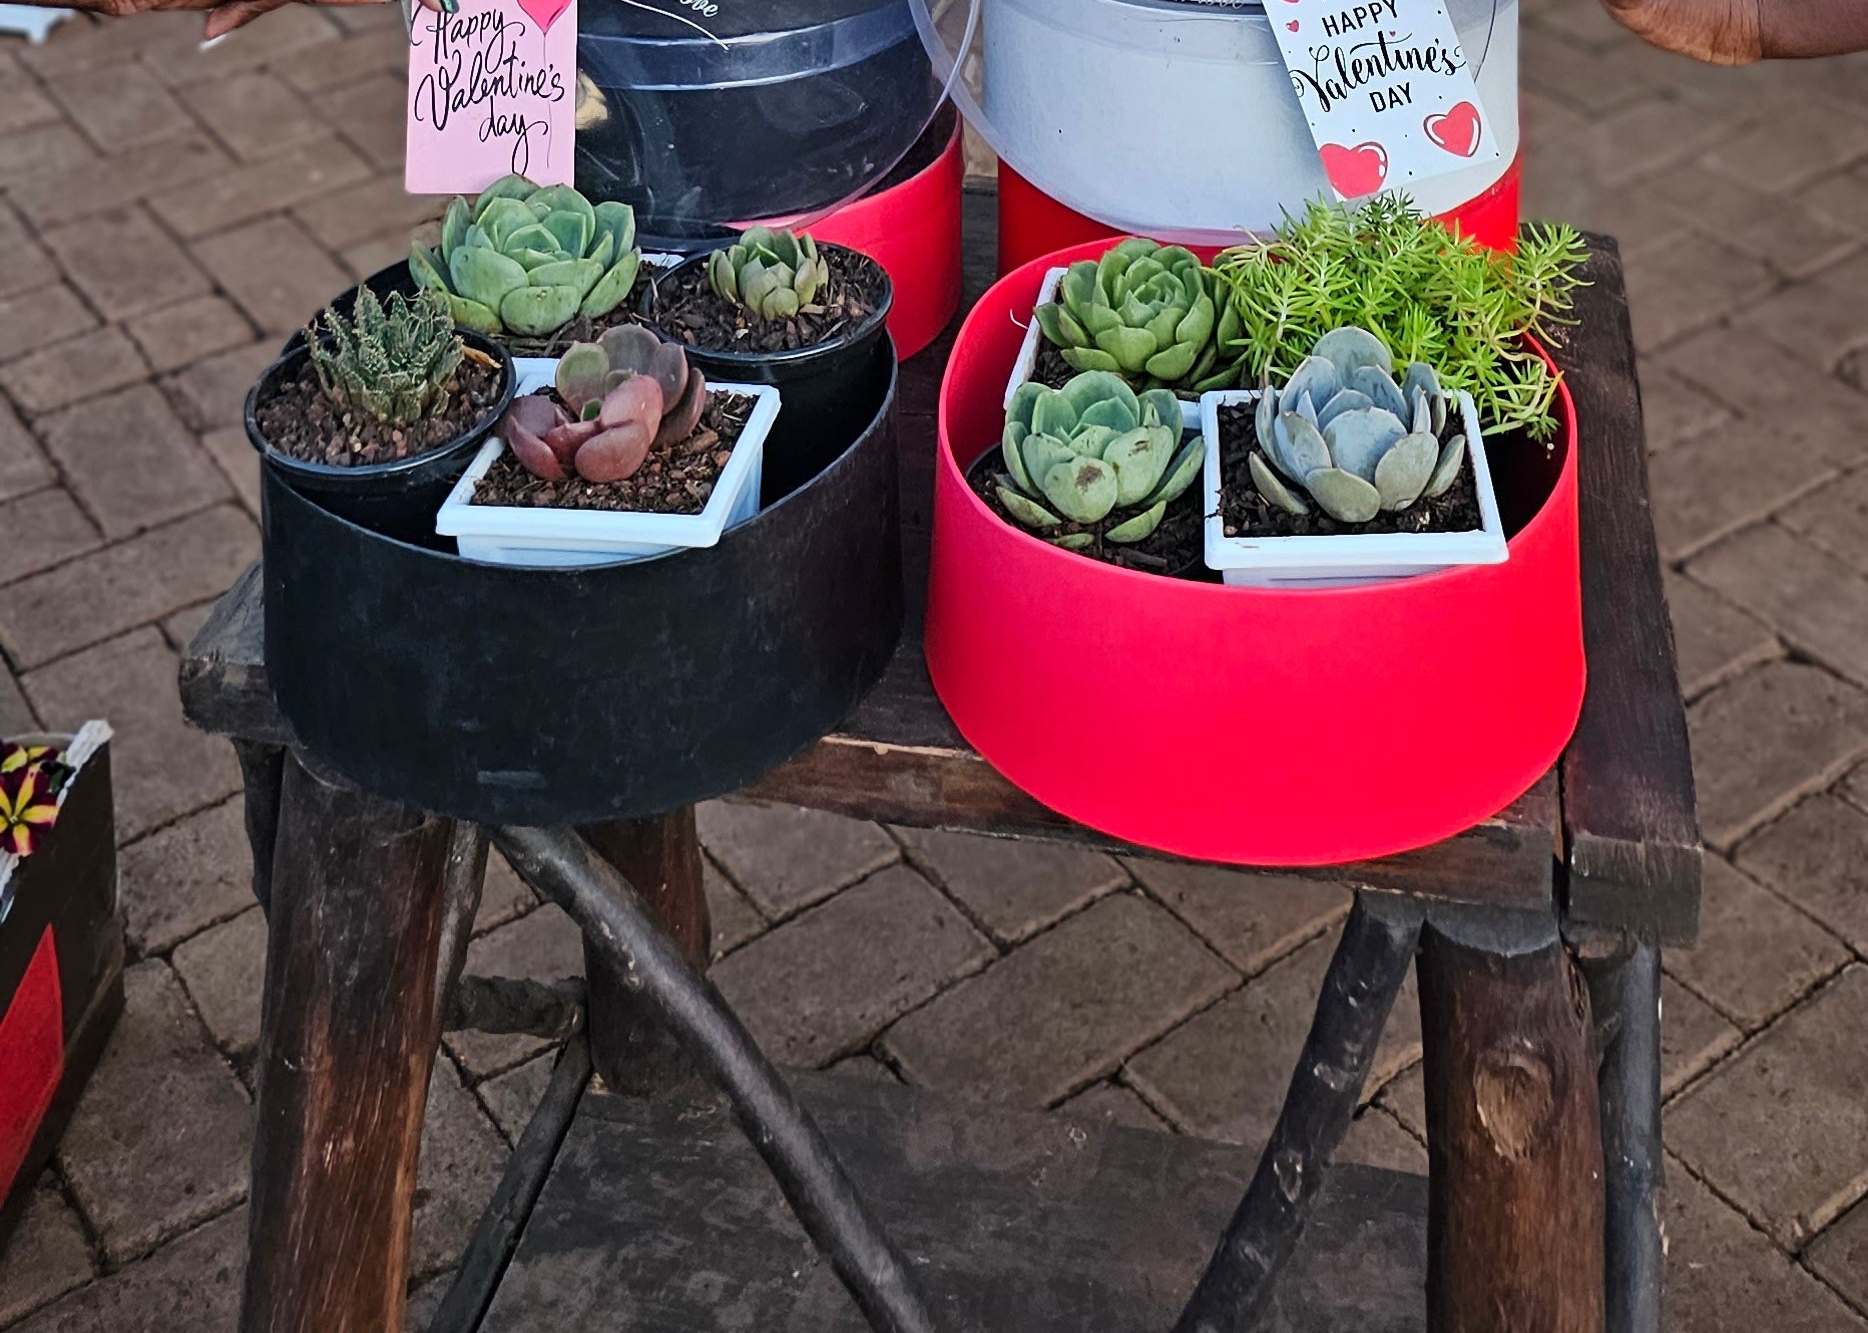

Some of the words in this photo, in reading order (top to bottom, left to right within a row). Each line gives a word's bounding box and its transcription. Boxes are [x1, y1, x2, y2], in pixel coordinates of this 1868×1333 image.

[414, 41, 565, 131] Valentine's
[1289, 30, 1467, 113] Valentine's
[1368, 82, 1413, 113] DAY
[479, 95, 548, 176] day
